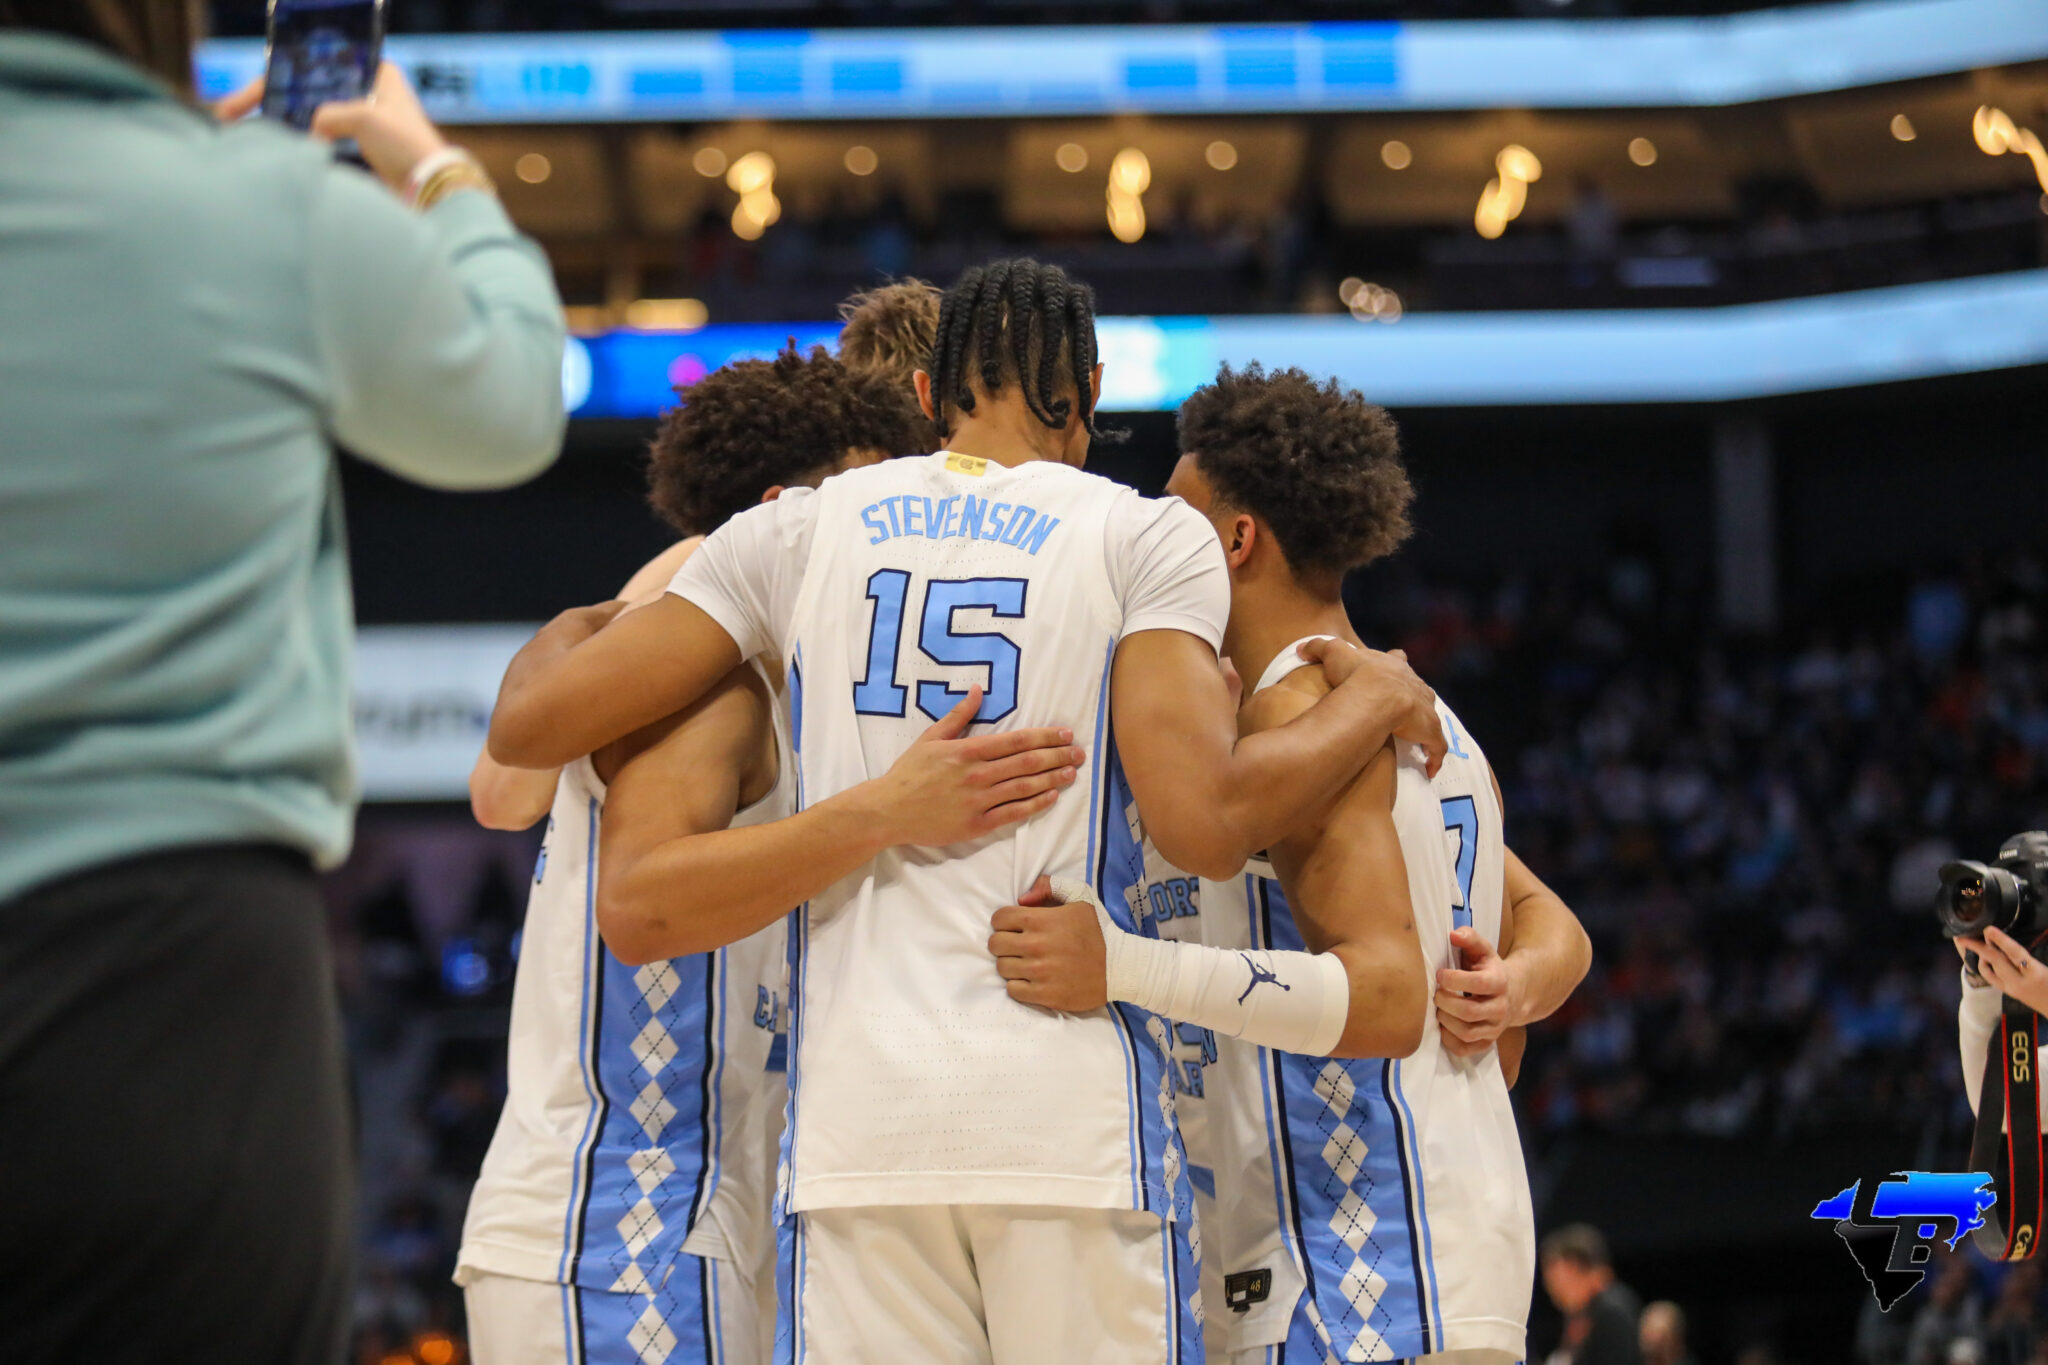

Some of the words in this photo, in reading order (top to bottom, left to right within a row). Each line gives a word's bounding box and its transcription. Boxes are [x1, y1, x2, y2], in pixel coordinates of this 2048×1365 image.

[861, 494, 1060, 556] STEVENSON
[853, 568, 1029, 723] 15
[2012, 1031, 2030, 1083] EOS
